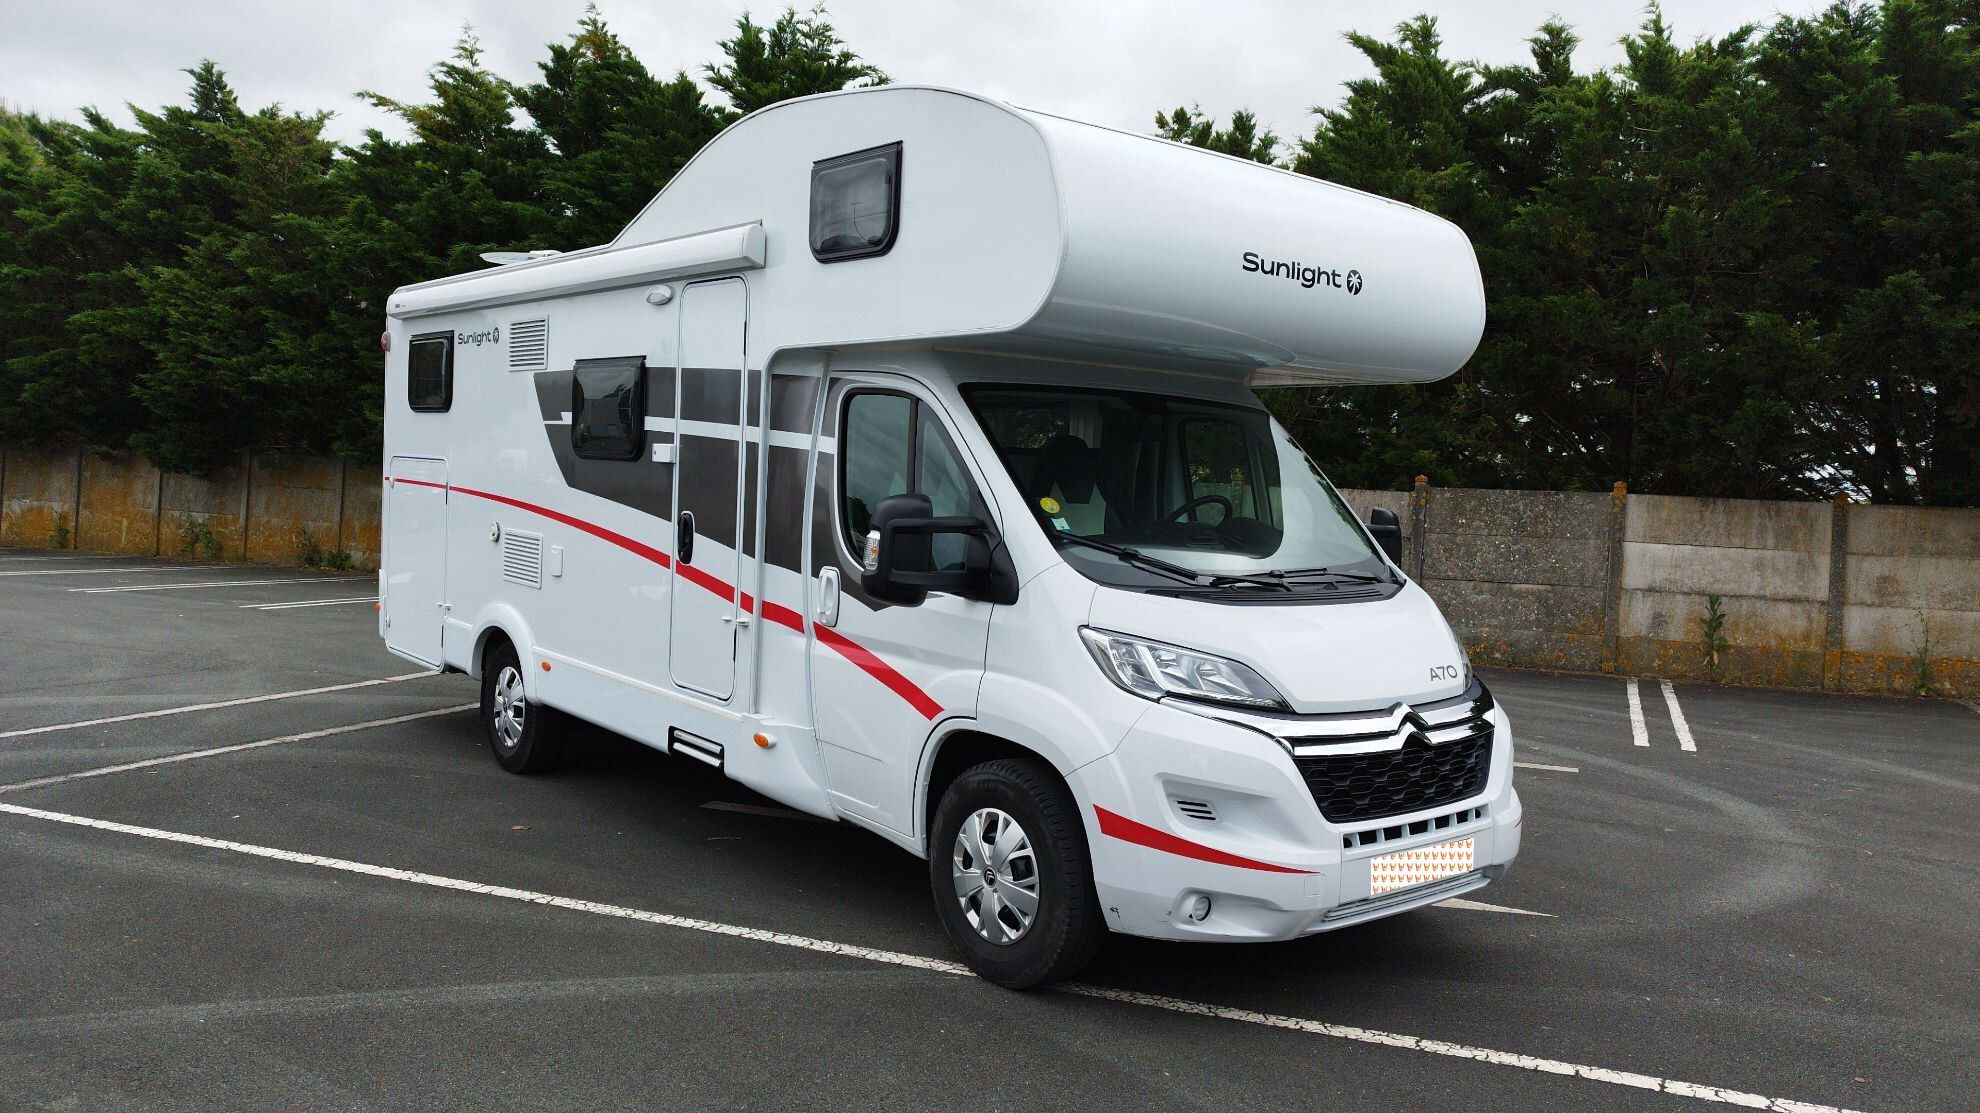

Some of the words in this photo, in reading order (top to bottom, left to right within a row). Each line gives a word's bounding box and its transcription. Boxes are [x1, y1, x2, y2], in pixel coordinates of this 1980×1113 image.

[1242, 251, 1342, 289] Sunlight
[457, 331, 492, 347] Sunlight
[1430, 664, 1458, 682] A70
